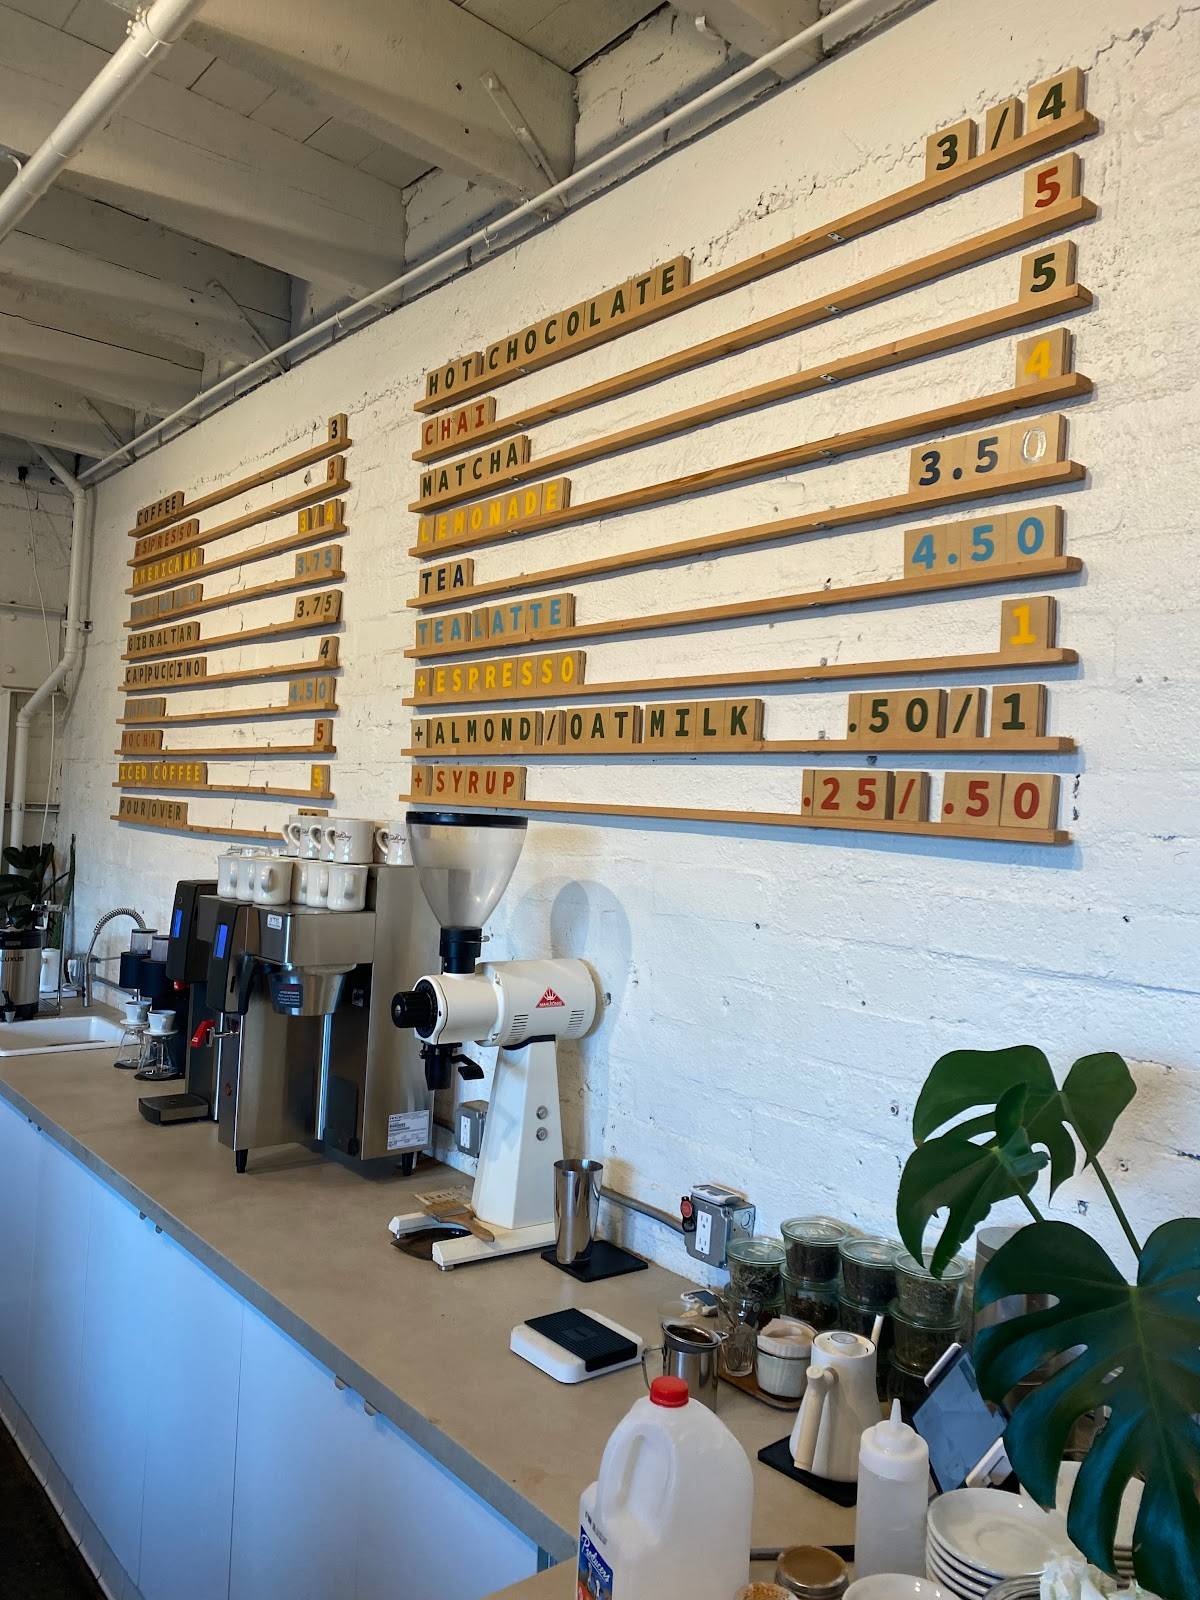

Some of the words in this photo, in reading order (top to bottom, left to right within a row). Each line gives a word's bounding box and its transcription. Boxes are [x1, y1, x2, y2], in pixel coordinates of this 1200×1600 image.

[1035, 166, 1061, 208] 5
[1030, 252, 1057, 293] 5
[428, 359, 472, 396] HOT
[488, 265, 675, 370] CHOCOLATE
[1024, 339, 1052, 378] 4
[332, 420, 338, 439] 3
[424, 403, 485, 446] CHAI
[328, 461, 335, 480] 3
[422, 442, 518, 498] MATCHA
[918, 428, 1047, 487] 3.50
[137, 496, 176, 526] COFFEE
[420, 483, 558, 544] LEMONADE
[135, 522, 192, 558] ESPRESSO
[911, 516, 1044, 570] 4.50
[134, 550, 197, 583] AMERICANO
[297, 549, 333, 576] 3.75
[422, 565, 464, 594] TEA
[297, 595, 332, 618] 3.75
[418, 619, 461, 645] TEA
[472, 599, 561, 638] LATTE
[128, 625, 192, 651] GIBRALTAR
[1009, 604, 1036, 645] 1
[320, 640, 330, 659] 4
[126, 660, 200, 683] CAPPUCCINO
[316, 723, 324, 742] 5
[650, 705, 749, 737] MILK
[121, 733, 156, 748] MOCHA
[120, 764, 147, 780] ICED
[153, 765, 200, 781] COFFEE
[120, 799, 146, 817] POUR
[151, 803, 181, 820] OVER
